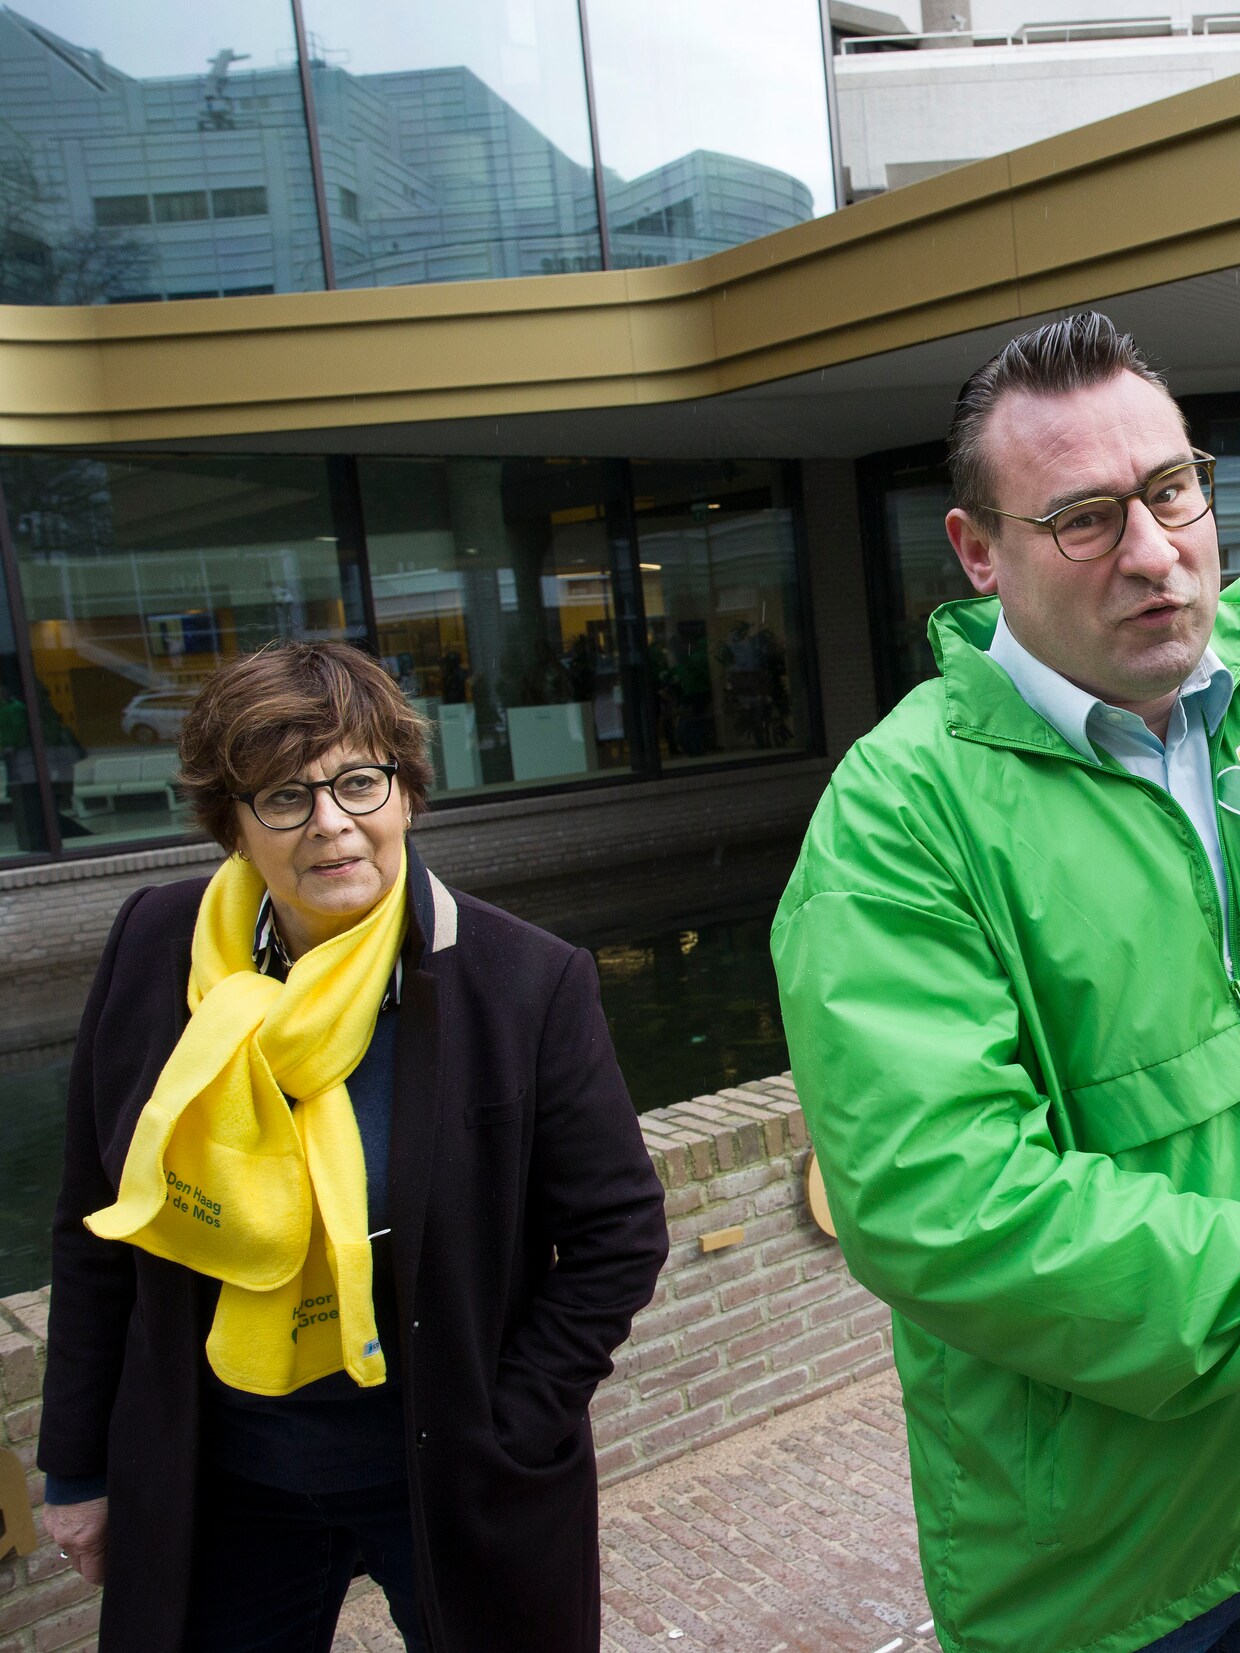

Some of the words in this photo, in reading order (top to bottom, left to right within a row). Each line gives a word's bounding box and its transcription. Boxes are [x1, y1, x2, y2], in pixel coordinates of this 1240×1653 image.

[166, 1170, 192, 1195] Den
[193, 1186, 222, 1216] Haag
[173, 1195, 189, 1213] de
[192, 1204, 221, 1229] Mos
